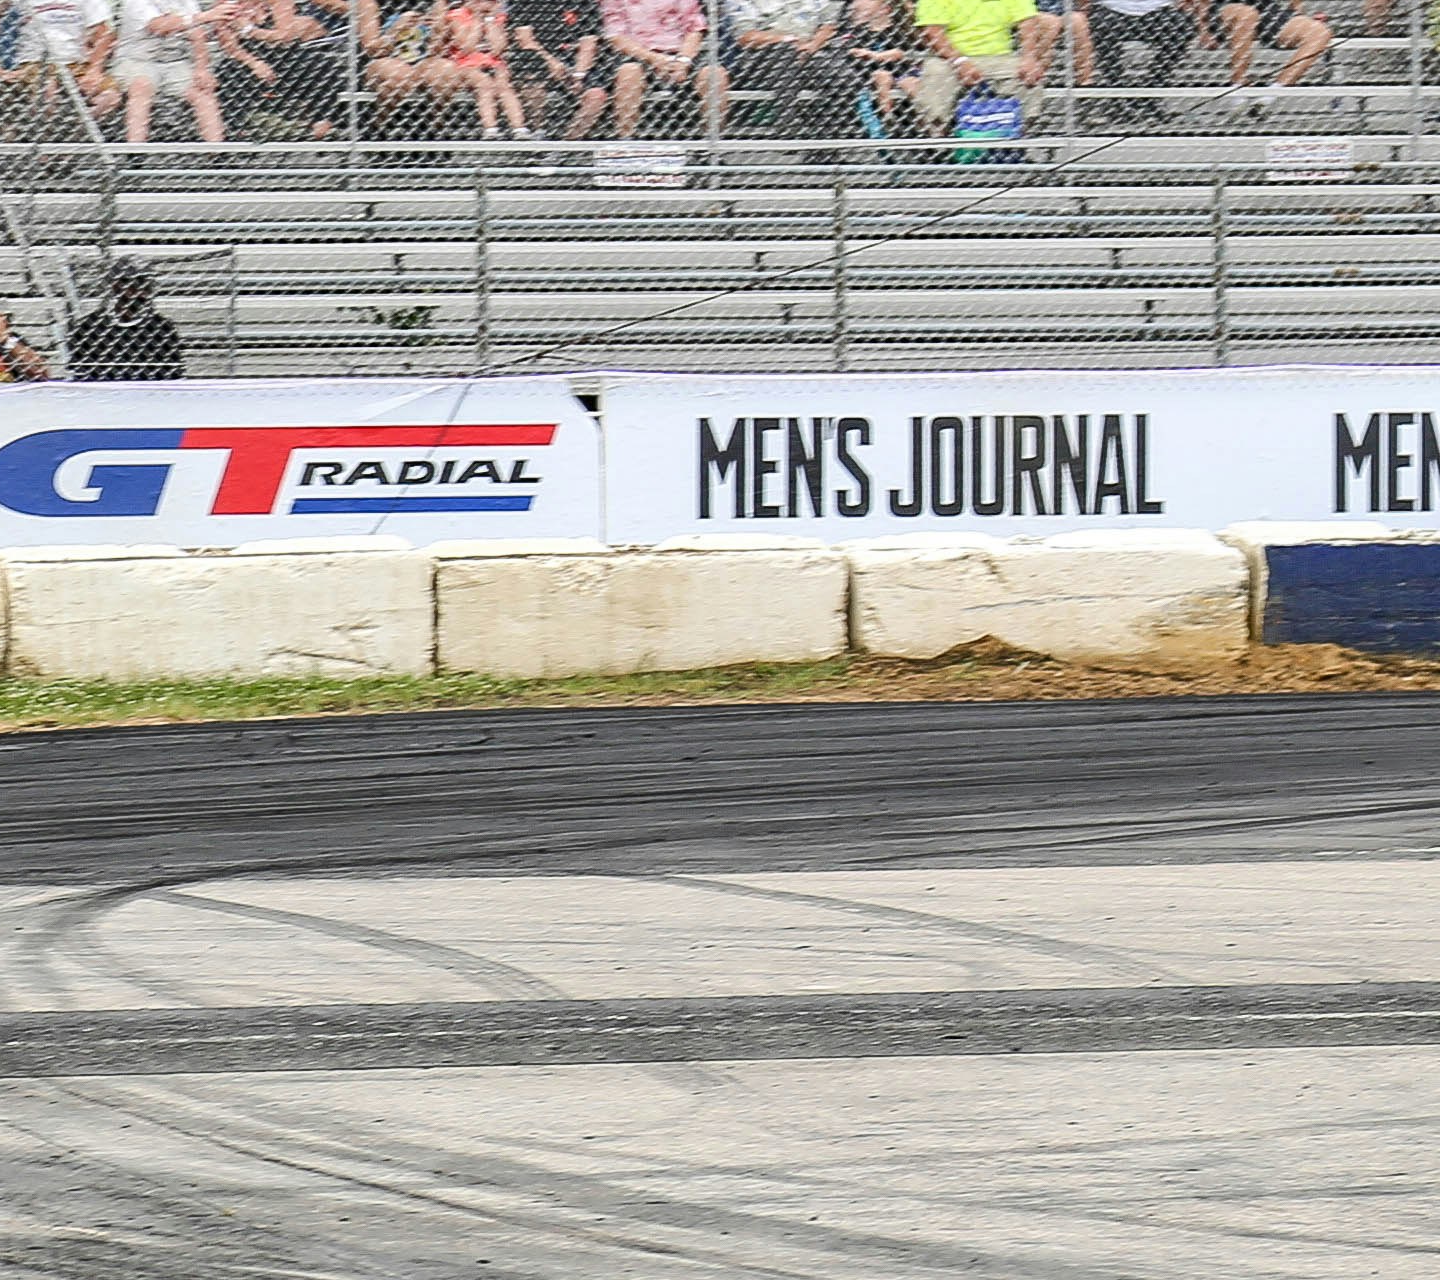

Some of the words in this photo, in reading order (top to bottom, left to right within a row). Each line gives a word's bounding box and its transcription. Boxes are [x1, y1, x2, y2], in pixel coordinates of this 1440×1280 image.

[298, 459, 542, 486] RADIAL
[697, 417, 872, 519] MEN'S
[887, 414, 1166, 517] JOURNAL
